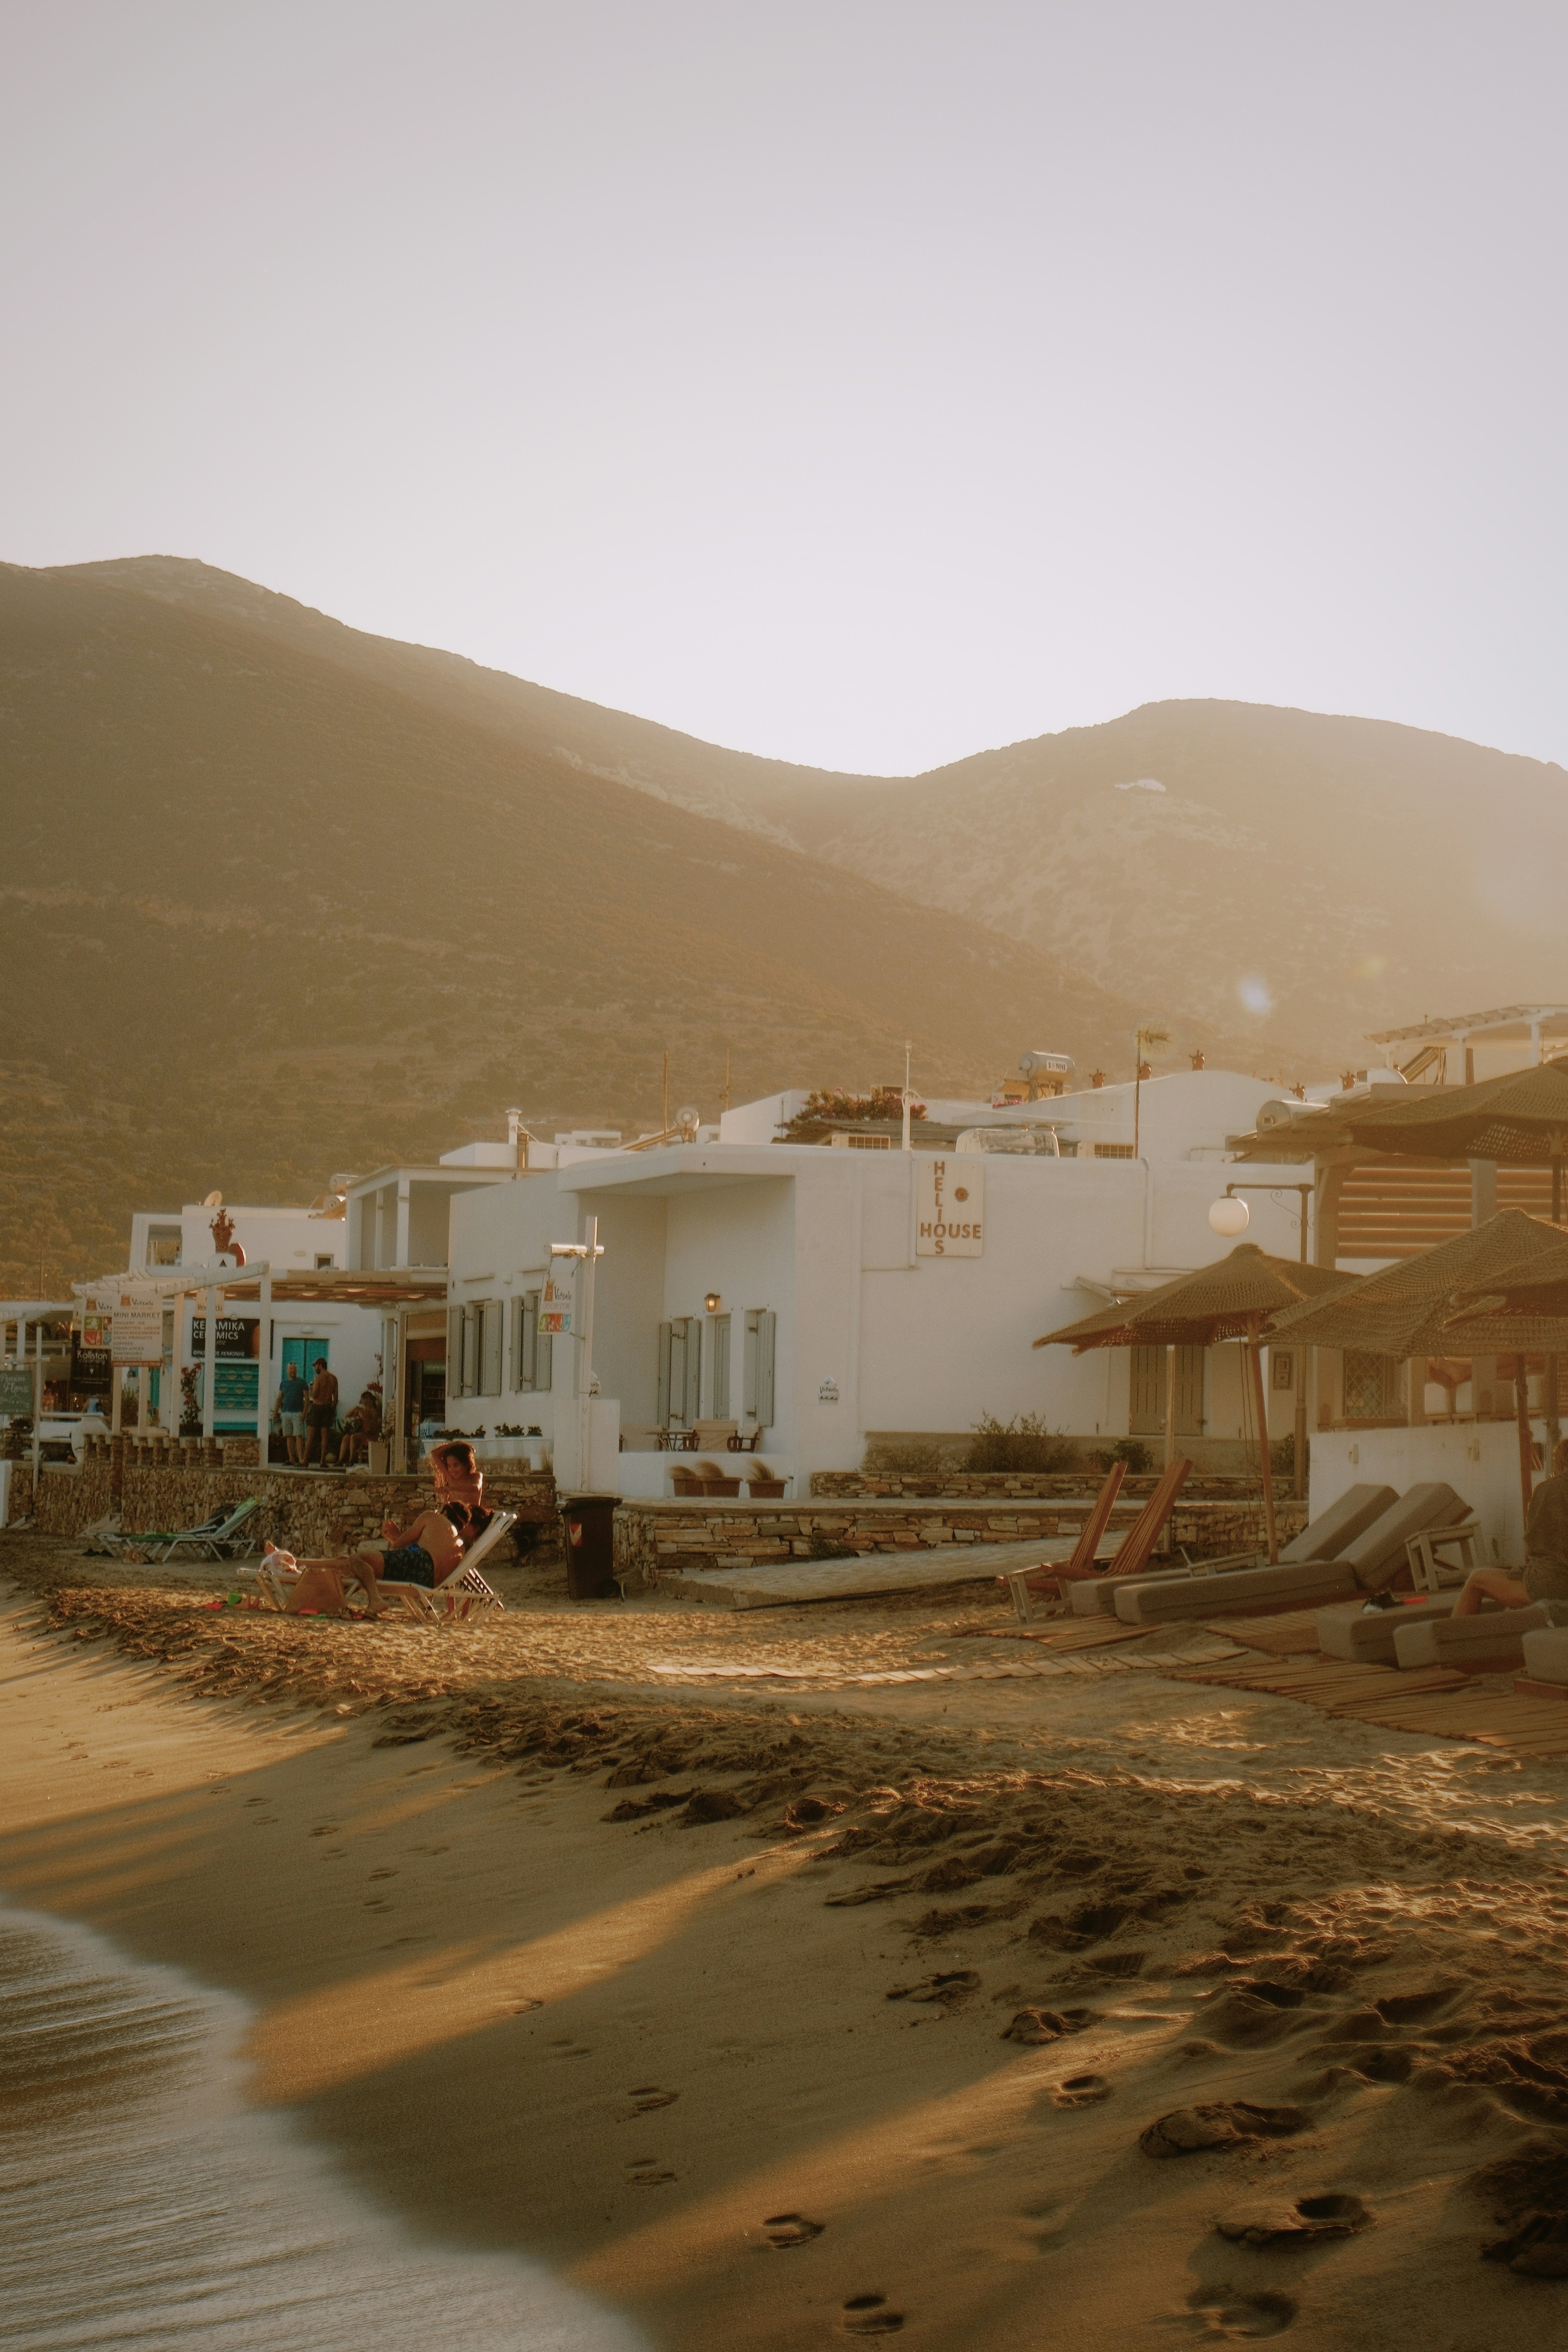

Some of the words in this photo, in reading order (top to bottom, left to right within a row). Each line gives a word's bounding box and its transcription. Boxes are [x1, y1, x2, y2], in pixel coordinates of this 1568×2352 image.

[934, 1161, 946, 1255] HELIOS
[920, 1222, 982, 1239] HOUSE
[98, 1302, 112, 1310] Vots
[193, 1320, 245, 1331] KEMIKA
[193, 1330, 239, 1340] CEMICS
